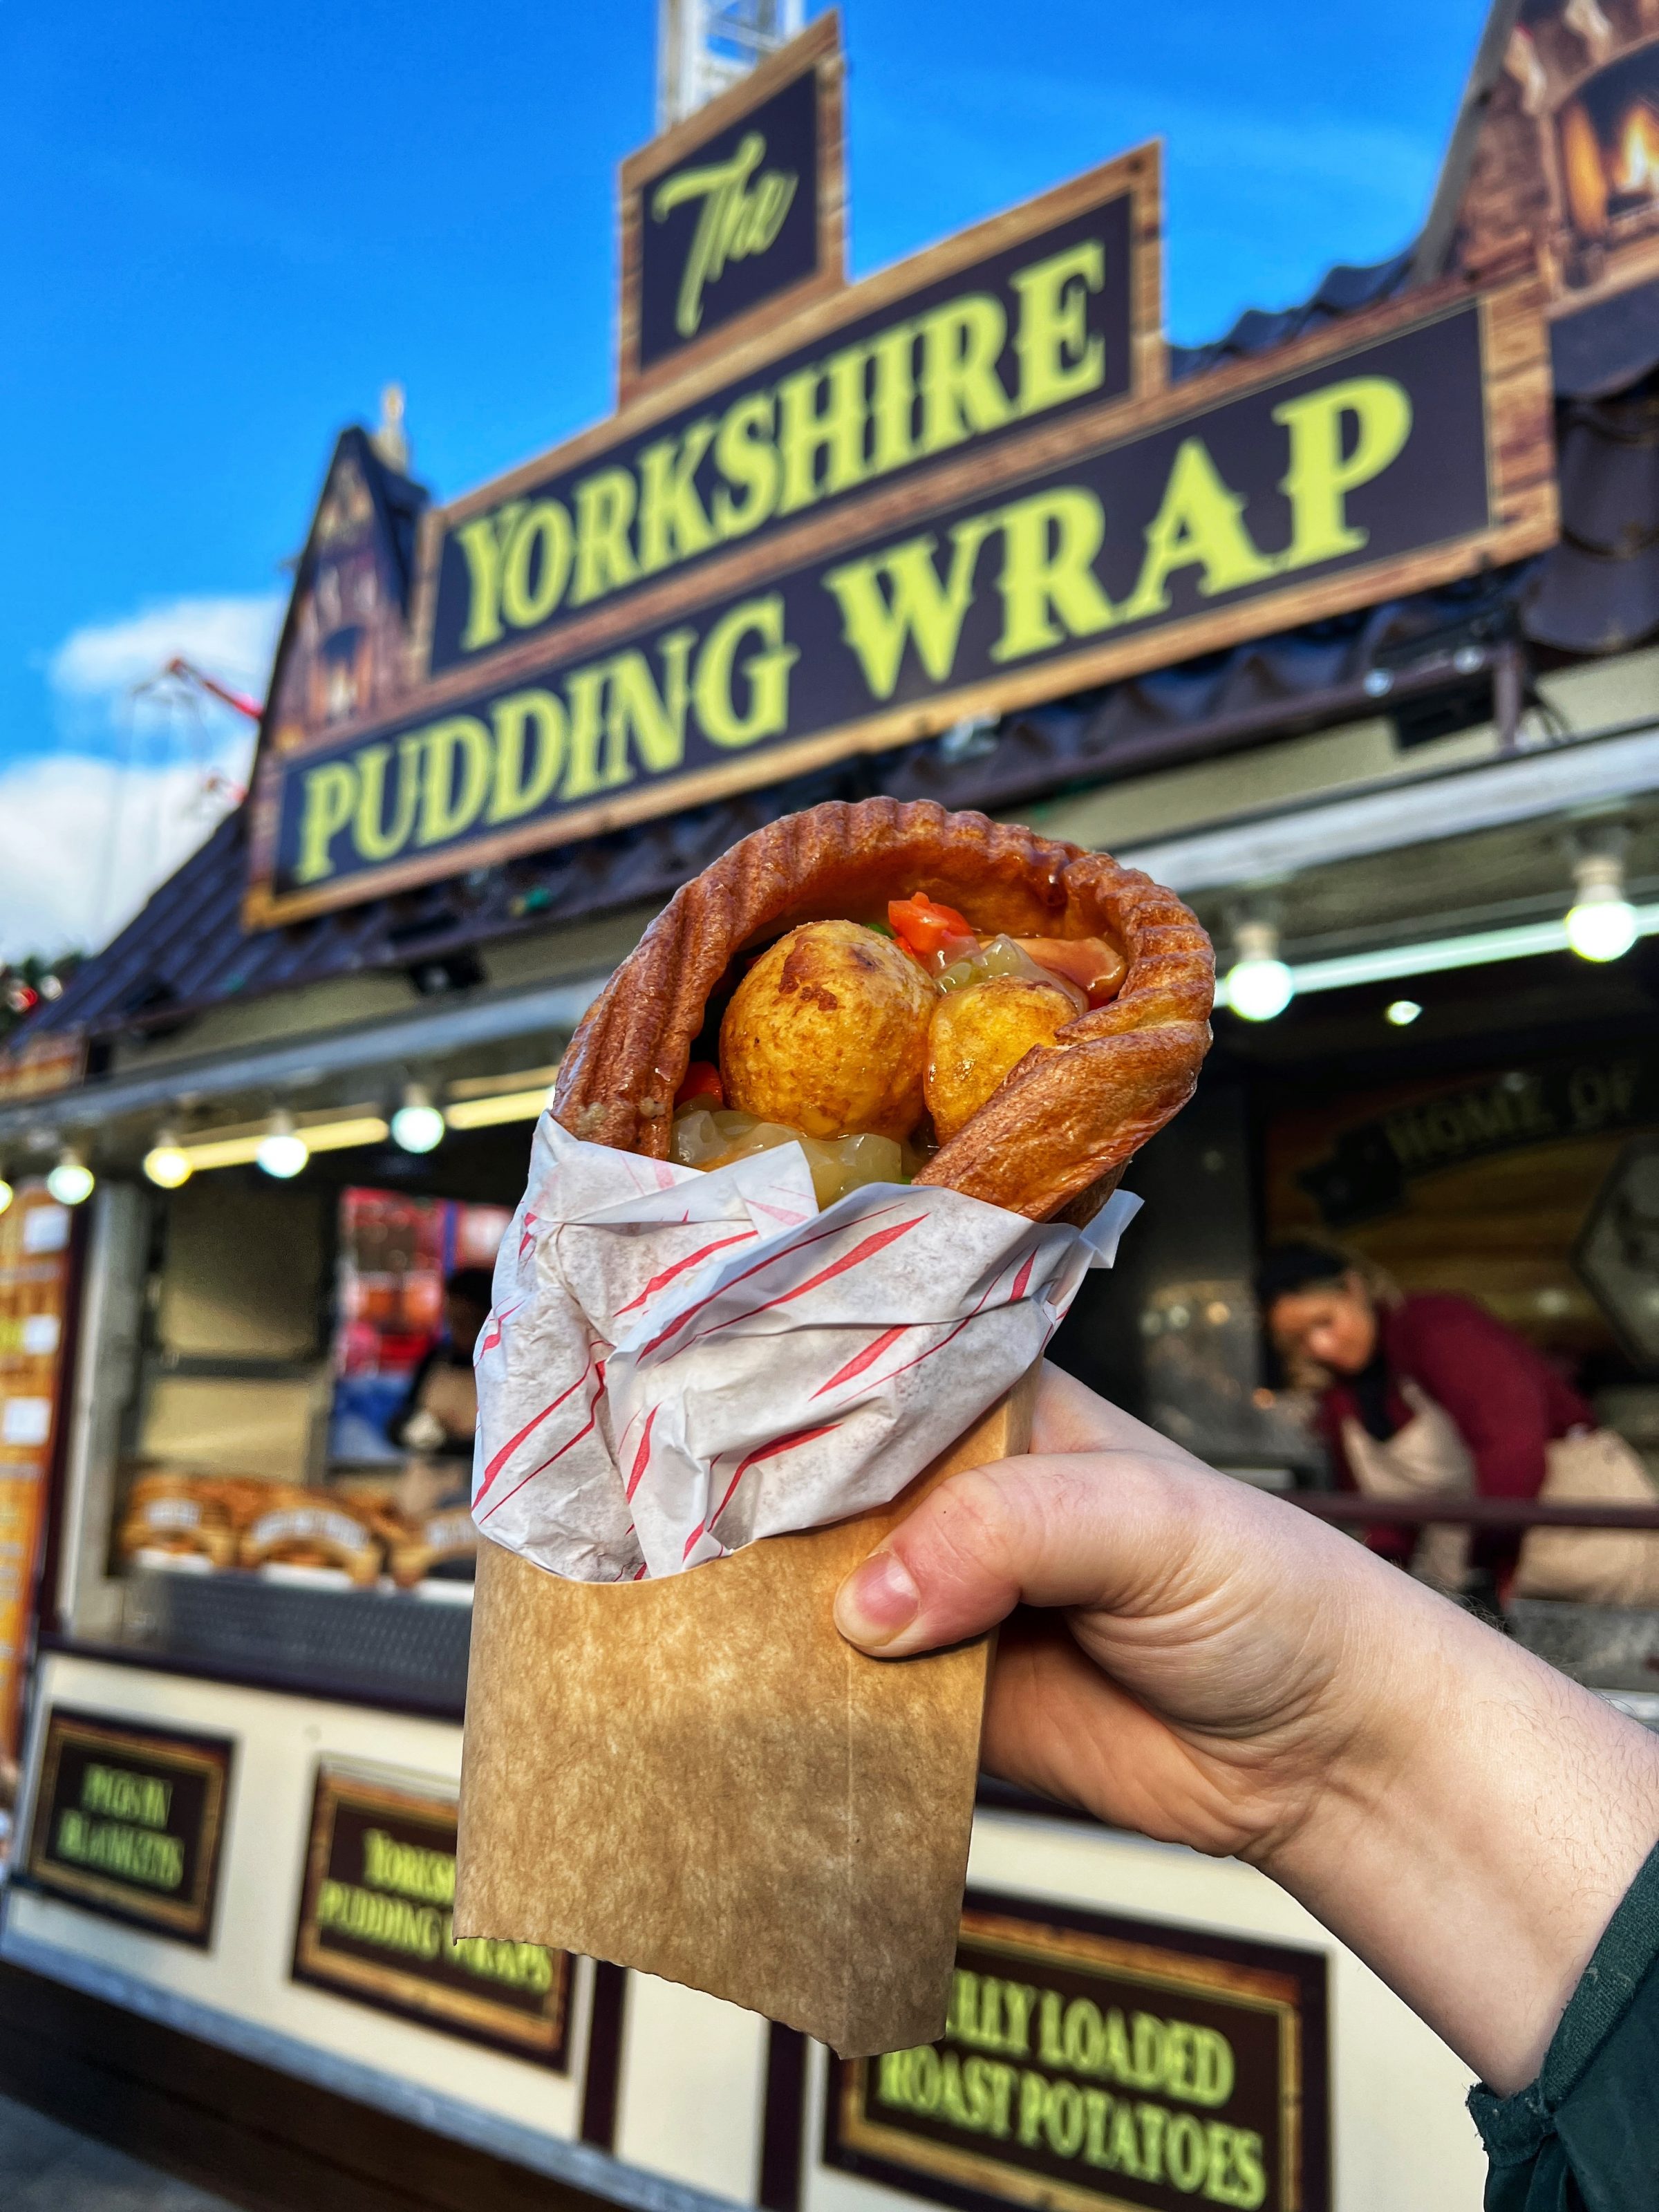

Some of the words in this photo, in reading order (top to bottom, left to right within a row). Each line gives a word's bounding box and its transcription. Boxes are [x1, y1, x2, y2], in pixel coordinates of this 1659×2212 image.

[653, 133, 798, 337] The
[456, 242, 1105, 651] YORKSHIRE
[296, 592, 799, 883] PUDDING
[825, 377, 1412, 700] WRAP
[317, 1877, 442, 1962] PUDDING
[877, 2043, 1020, 2140] ROAST
[1018, 2069, 1268, 2211] POTATOES
[1038, 1988, 1236, 2108] LOADED
